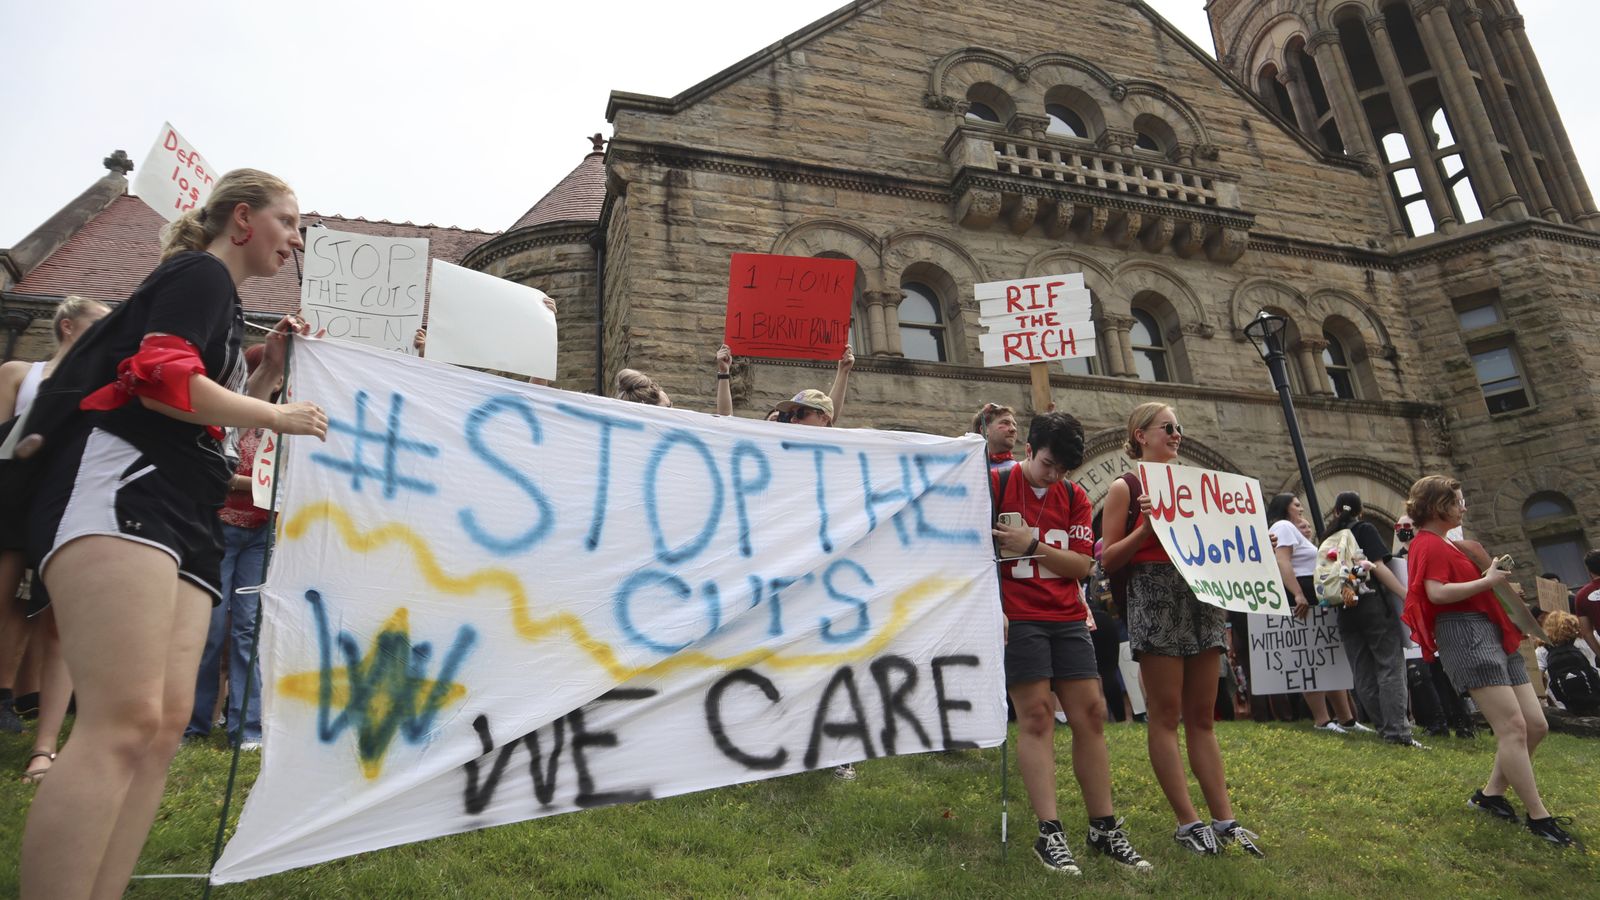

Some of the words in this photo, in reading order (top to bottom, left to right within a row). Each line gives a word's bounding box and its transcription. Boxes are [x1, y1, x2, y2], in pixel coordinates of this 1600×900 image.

[172, 165, 200, 201] los
[310, 235, 416, 283] STOP
[307, 279, 349, 304] THE
[360, 284, 417, 310] CUTS
[743, 264, 758, 289] 1
[775, 266, 846, 294] HONK
[1006, 281, 1066, 313] RIF
[309, 309, 402, 341] JOIN
[731, 311, 747, 339] 1
[751, 312, 809, 340] BURNT
[1015, 312, 1062, 328] THE
[1003, 328, 1077, 363] RICH
[1139, 464, 1194, 523] We
[1201, 473, 1257, 515] Need
[1169, 524, 1262, 567] World
[612, 557, 875, 654] CUTS
[1251, 627, 1309, 651] WITHOUT
[1265, 651, 1283, 671] IS
[1291, 645, 1340, 669] JUST
[464, 687, 657, 815] WE
[704, 654, 981, 771] CARE
